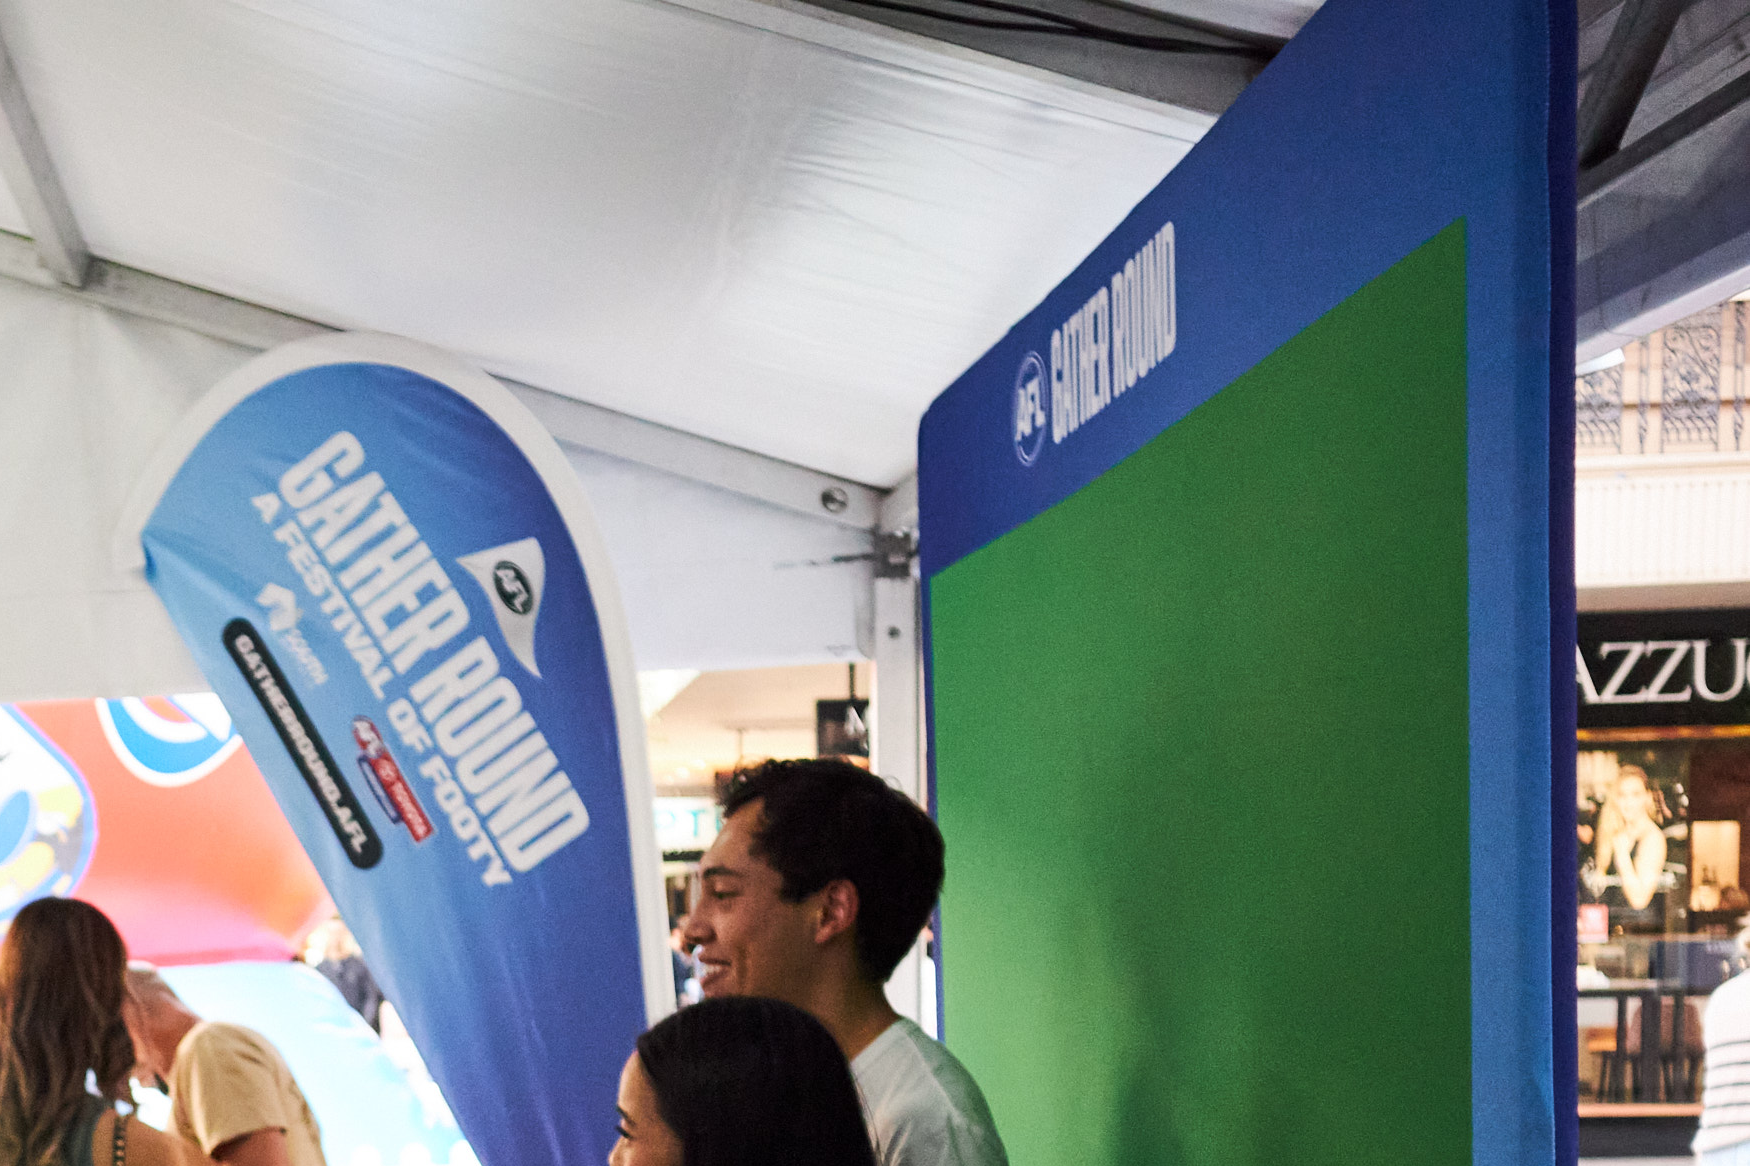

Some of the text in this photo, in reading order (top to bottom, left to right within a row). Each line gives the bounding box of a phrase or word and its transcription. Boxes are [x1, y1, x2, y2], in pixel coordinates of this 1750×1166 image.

[1015, 220, 1177, 444] AFL GATHER ROUND
[234, 633, 368, 854] GATHERROUND.AFL
[252, 492, 281, 525] A
[273, 519, 394, 701] FESTIVAL
[386, 697, 434, 753] OF
[419, 754, 513, 887] FOOTY
[279, 430, 590, 873] GATHER ROUND
